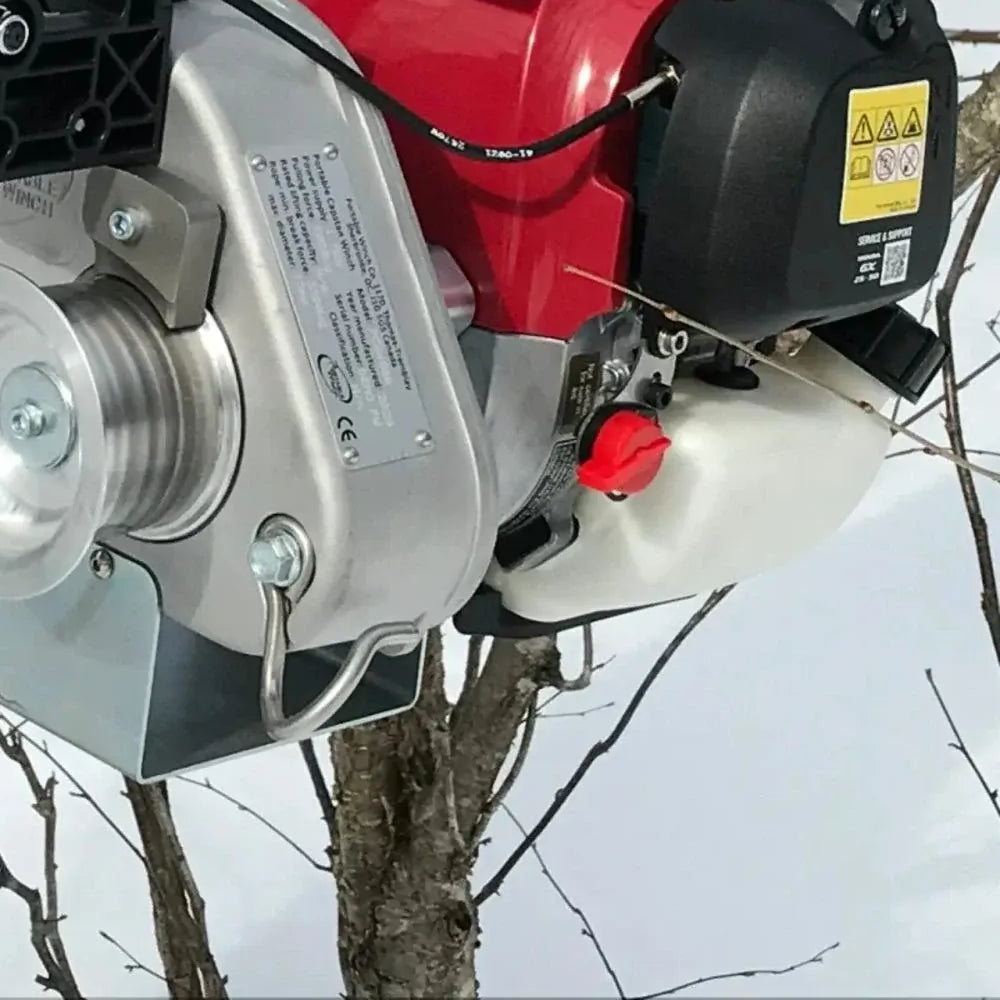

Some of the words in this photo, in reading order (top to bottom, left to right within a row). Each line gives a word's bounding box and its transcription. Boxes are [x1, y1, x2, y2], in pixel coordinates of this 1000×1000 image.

[291, 157, 306, 190] Pulling
[302, 155, 316, 186] Power
[2, 182, 54, 218] WINCH
[279, 159, 295, 188] Rated
[290, 190, 303, 218] lifting
[313, 153, 330, 195] Portable
[326, 197, 344, 237] Capstan
[340, 239, 355, 271] Winch
[286, 215, 300, 244] break
[857, 232, 882, 246] SERVICE
[887, 226, 913, 241] SUPPORT
[334, 294, 350, 321] Serial
[346, 291, 357, 313] Year
